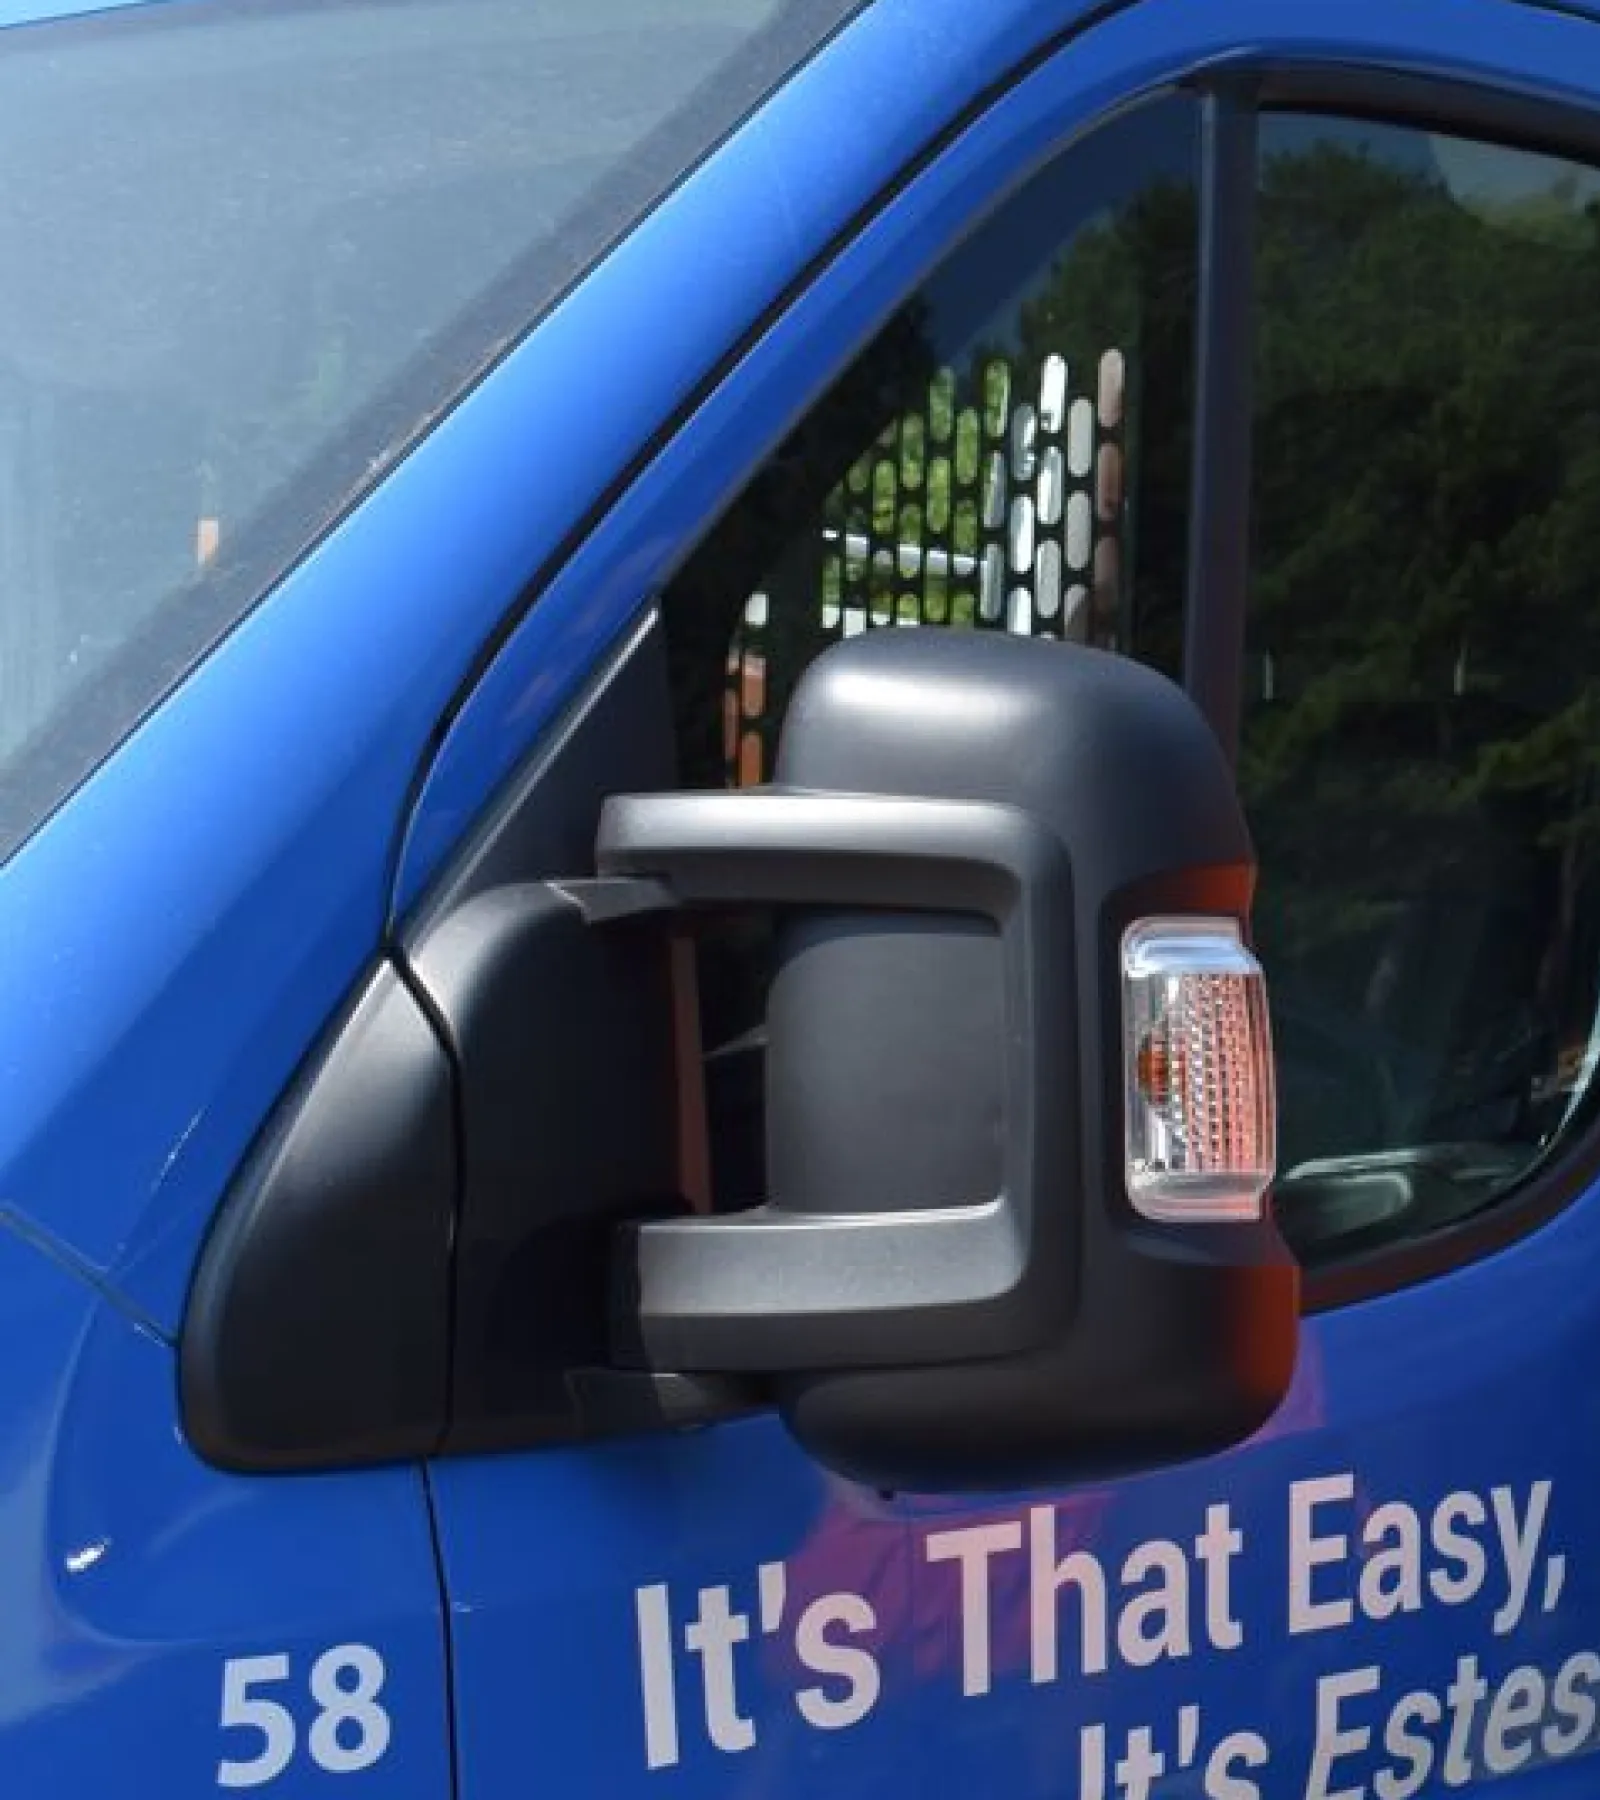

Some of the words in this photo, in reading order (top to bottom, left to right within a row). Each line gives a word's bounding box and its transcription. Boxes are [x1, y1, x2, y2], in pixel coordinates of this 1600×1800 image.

[635, 1562, 882, 1771] It's
[925, 1503, 1245, 1698] That
[1286, 1473, 1565, 1636] Easy,
[217, 1643, 391, 1788] 58
[1077, 1705, 1269, 1800] It's
